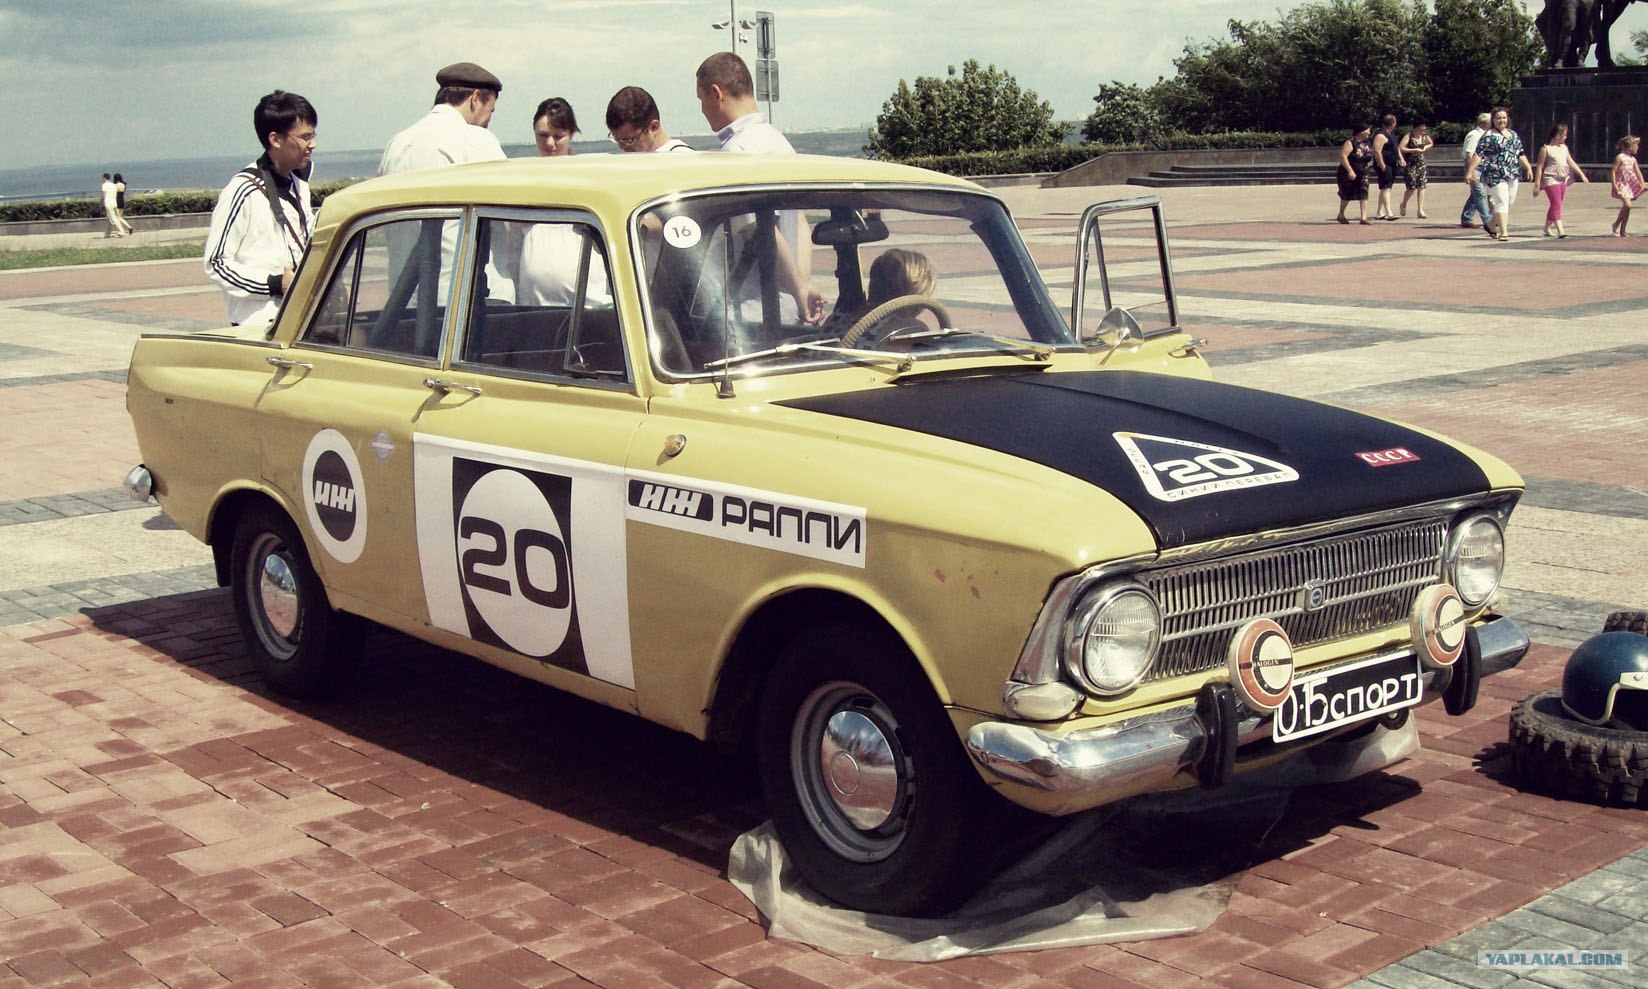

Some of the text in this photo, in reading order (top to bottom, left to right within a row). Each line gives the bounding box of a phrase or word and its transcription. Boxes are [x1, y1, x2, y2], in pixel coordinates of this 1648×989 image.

[671, 225, 692, 239] 16
[1152, 452, 1255, 484] 20
[1361, 449, 1412, 463] СССР
[314, 480, 356, 513] ИЖ
[638, 483, 703, 519] ИЖ
[460, 515, 570, 610] 20
